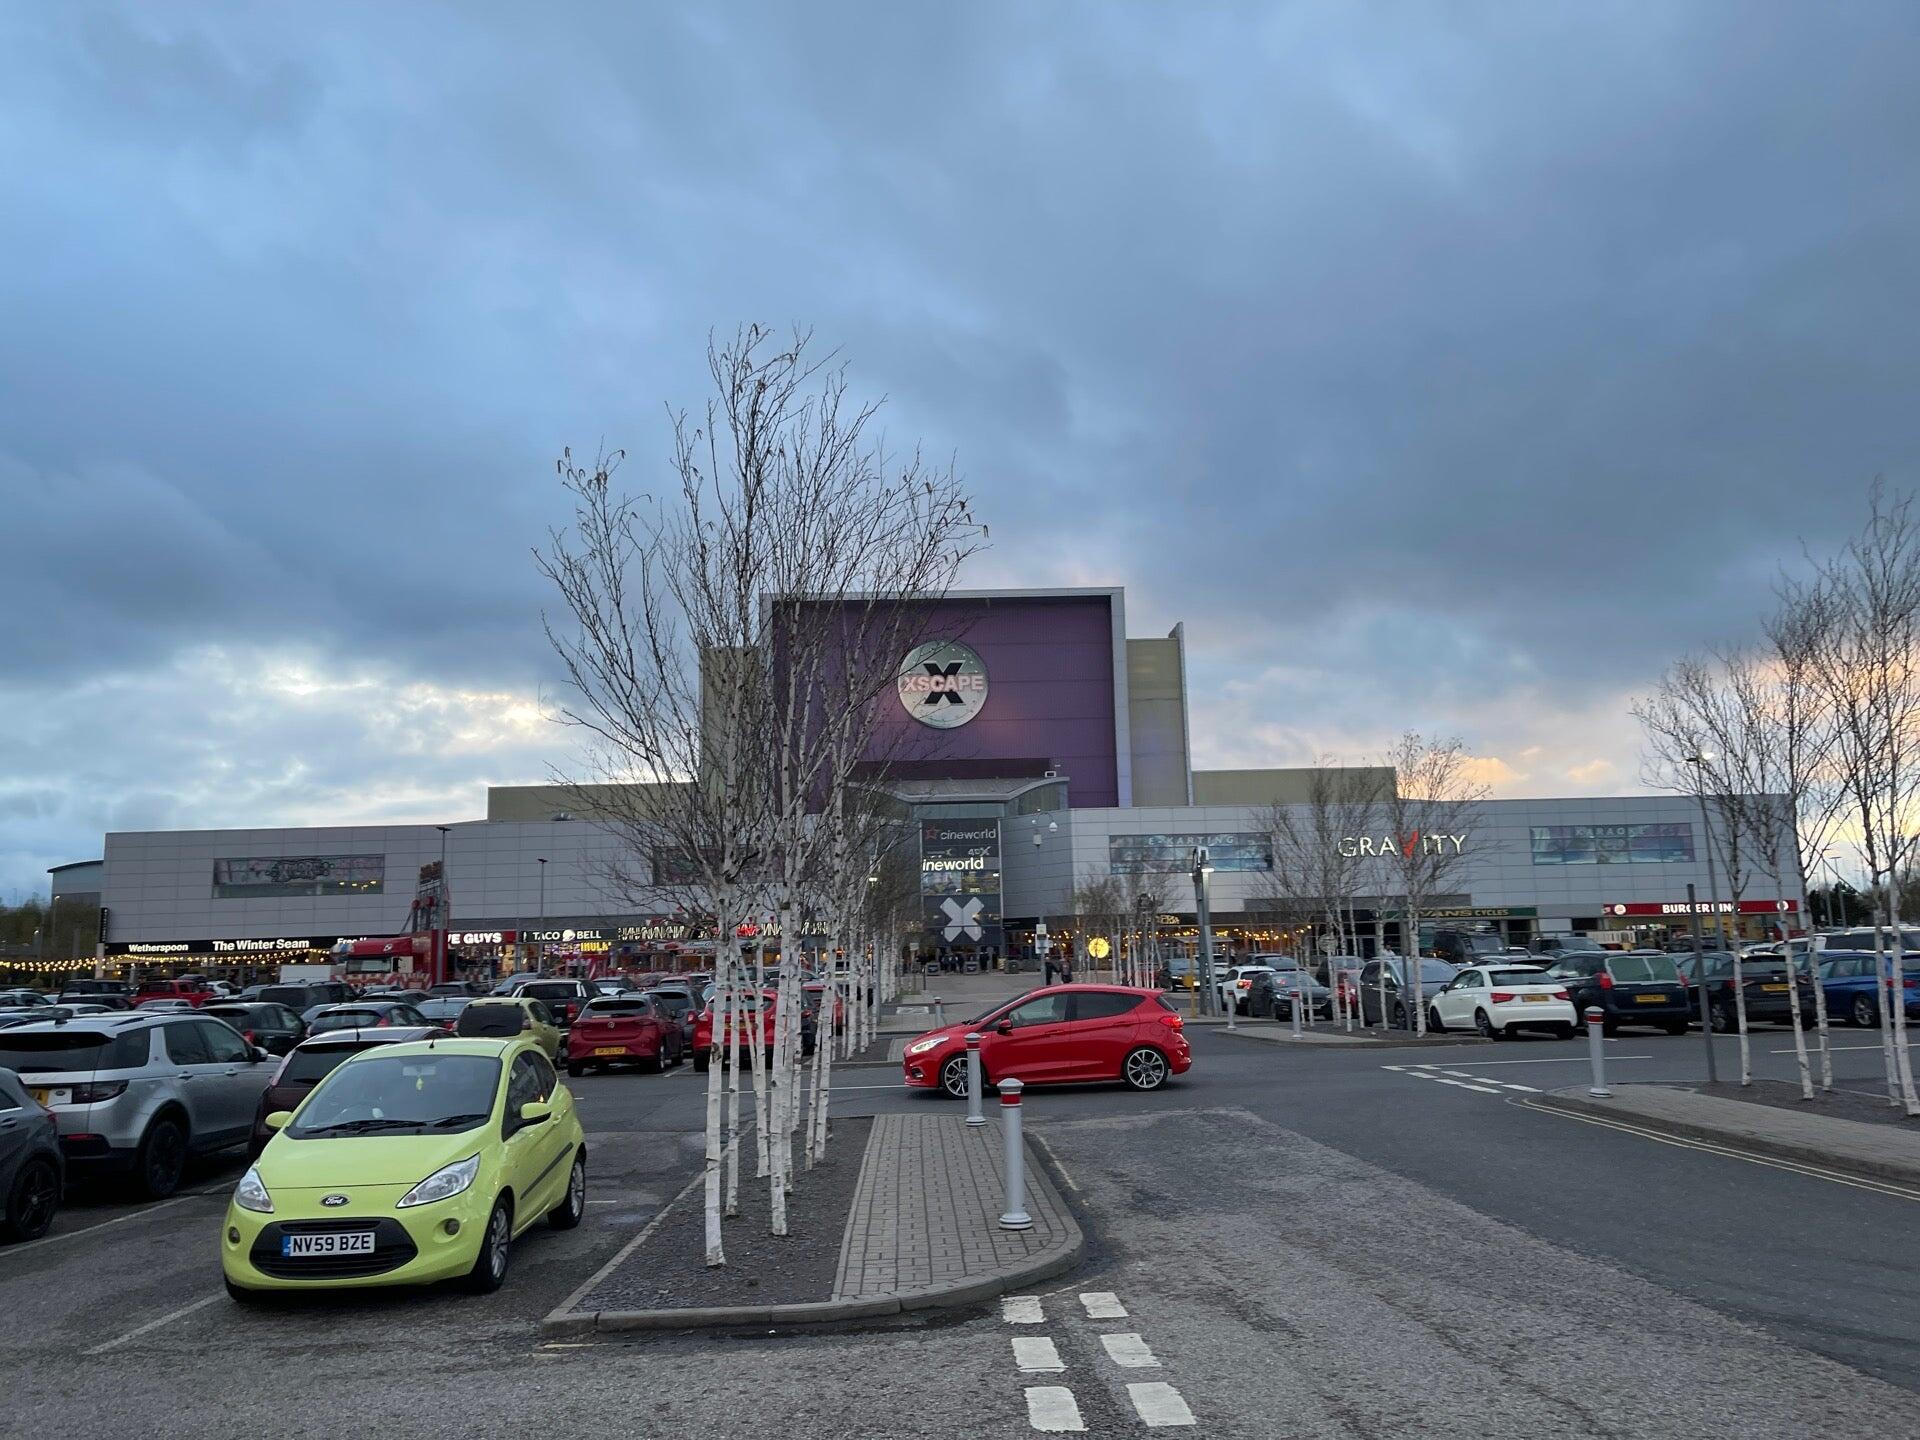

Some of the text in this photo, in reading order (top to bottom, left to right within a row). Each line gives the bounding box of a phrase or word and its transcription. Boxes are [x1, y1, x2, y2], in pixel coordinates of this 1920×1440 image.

[903, 674, 984, 692] XSCAPE
[940, 828, 996, 840] cineworld
[1337, 831, 1467, 859] GRAVITY
[463, 932, 502, 944] GUYS
[532, 930, 602, 940] TACO BELL
[128, 943, 189, 953] Wetherspoon
[212, 939, 310, 951] The Winter Seam
[292, 1234, 371, 1253] NV59 BZE
